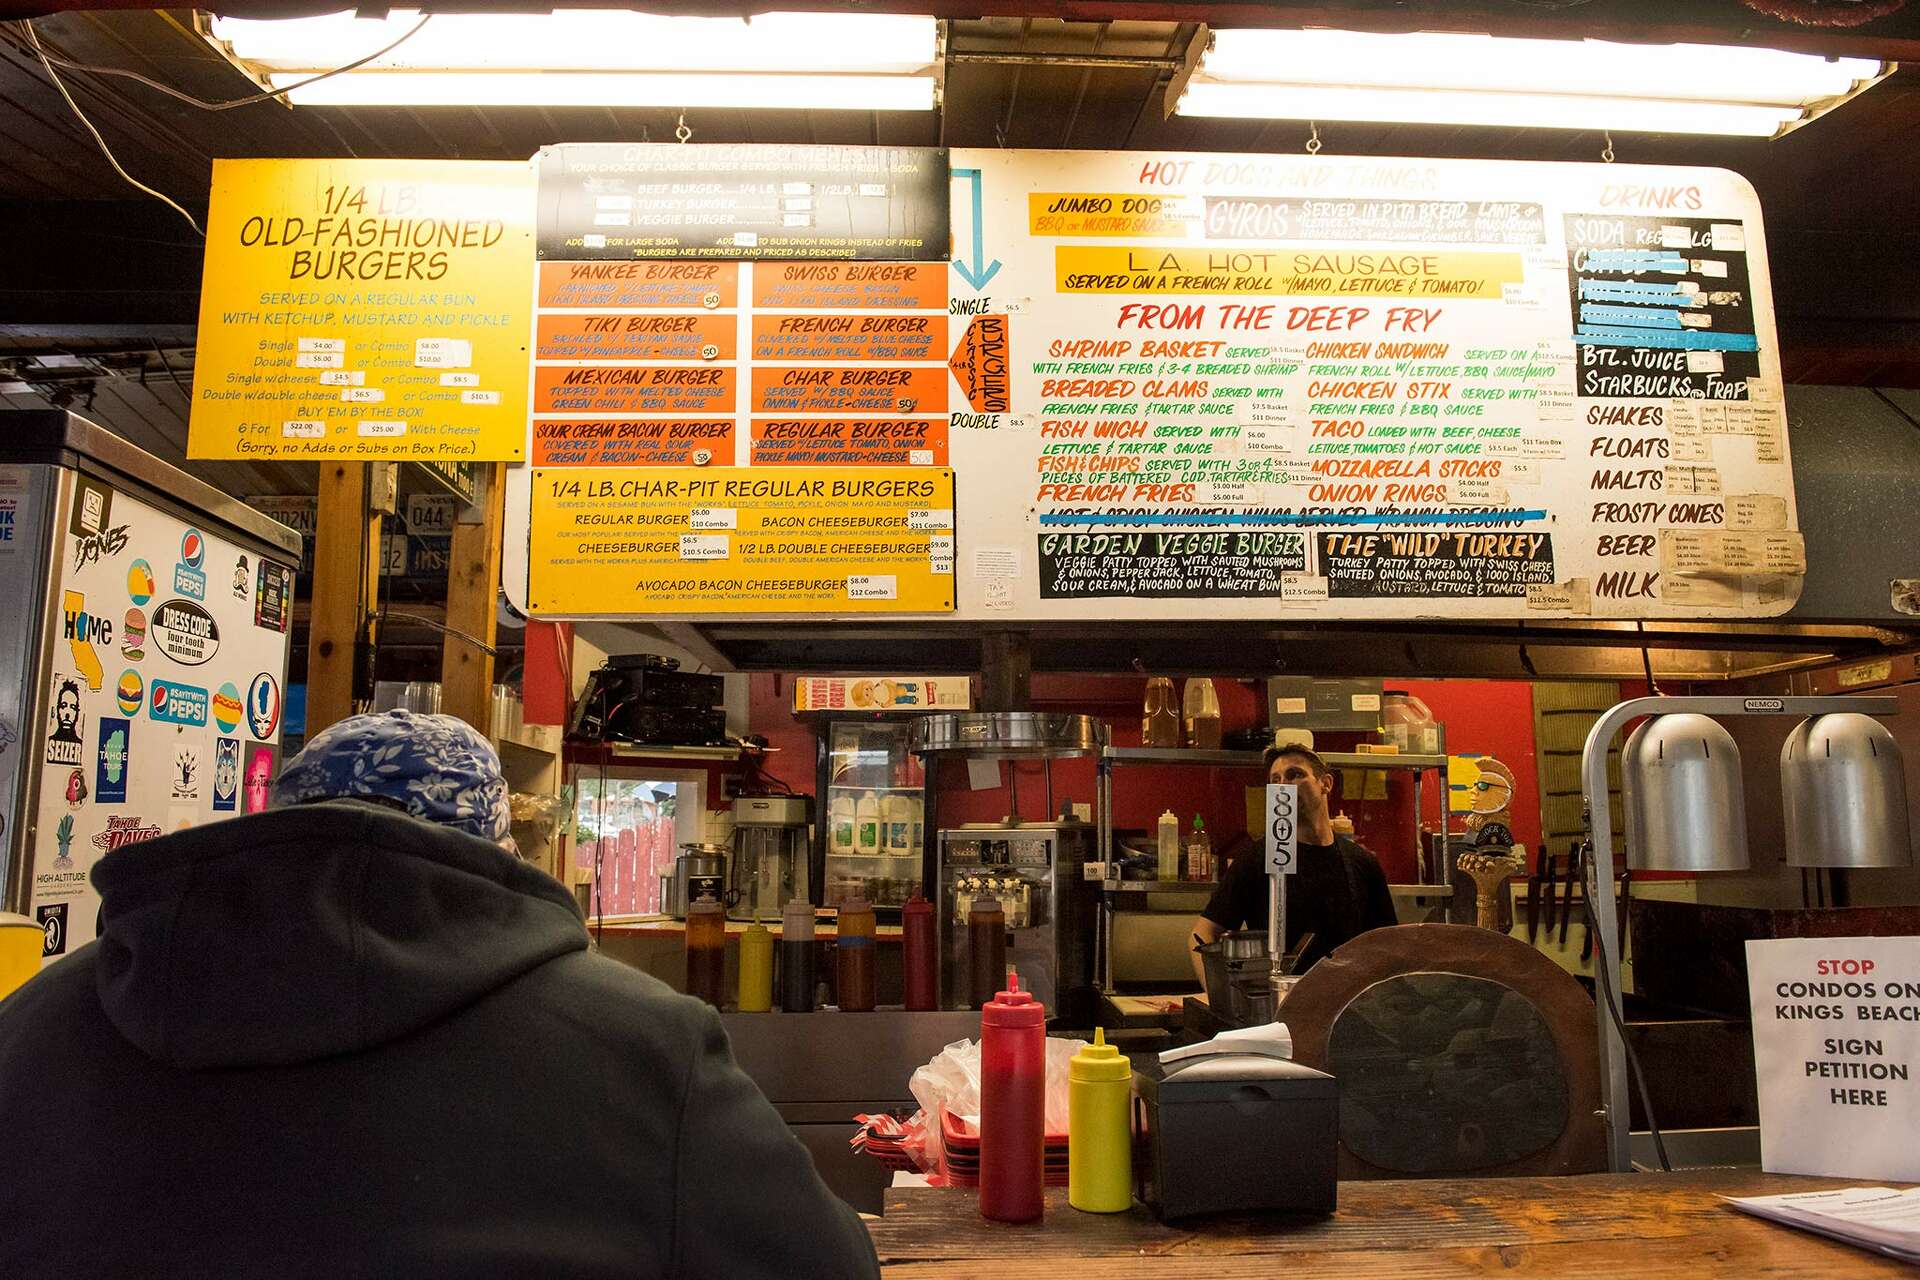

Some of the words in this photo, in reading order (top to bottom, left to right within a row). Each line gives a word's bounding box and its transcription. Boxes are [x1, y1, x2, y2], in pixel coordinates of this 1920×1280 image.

[1139, 161, 1194, 184] HOT
[324, 185, 368, 214] 1/4
[1048, 198, 1113, 214] JUMBO
[1122, 199, 1162, 213] DOG
[1599, 184, 1702, 210] DRINKS
[1210, 200, 1290, 235] GYROS
[240, 216, 503, 248] OLD-FASHIONED
[1575, 220, 1624, 242] SODA
[290, 251, 449, 281] BURGERS
[571, 265, 639, 280] YANKEE
[646, 265, 720, 281] BURGER
[1209, 255, 1277, 273] HOT
[1294, 254, 1440, 275] SAUSAGE
[784, 266, 841, 281] SWISS
[847, 266, 918, 282] BURGER
[1065, 274, 1130, 289] SERVED
[1133, 276, 1154, 290] ON
[1157, 277, 1167, 289] A
[1173, 276, 1229, 290] FRENCH
[1233, 277, 1273, 290] ROLL
[1340, 279, 1404, 292] LETTUCE
[1422, 280, 1484, 294] TOMATO!
[949, 297, 991, 316] SINGLE
[223, 313, 260, 325] WITH
[343, 313, 418, 326] MUSTARD
[423, 313, 455, 326] AND
[460, 313, 510, 326] PICKLE
[585, 317, 622, 333] TIKI
[629, 317, 697, 333] BURGER
[780, 317, 849, 334] FRENCH
[856, 317, 930, 334] BURGER
[1117, 304, 1203, 330] FROM
[1220, 305, 1274, 330] THE
[1286, 306, 1370, 332] DEEP
[1385, 307, 1442, 333] FRY
[1048, 340, 1132, 358] SHRIMP
[1140, 340, 1226, 358] BASKET
[1225, 347, 1271, 358] SERVED
[1306, 342, 1371, 359] CHICKEN
[1375, 342, 1449, 359] SANDWICH
[977, 318, 1006, 412] BURGERS
[1631, 349, 1686, 370] JUICE
[564, 370, 650, 386] MEXICAN
[655, 370, 723, 386] BURGER
[783, 370, 834, 386] CHAR
[840, 370, 913, 386] BURGER
[1585, 369, 1692, 395] STARBUCKS
[1707, 373, 1748, 400] FRAP
[1040, 379, 1135, 398] BREADED
[1142, 380, 1209, 398] CLAMS
[1308, 381, 1397, 399] CHICKEN
[1406, 381, 1452, 399] STIX
[950, 412, 1000, 430] DOUBLE
[1587, 406, 1663, 426] SHAKES
[537, 423, 571, 440] SOUR
[573, 423, 615, 439] CREAM
[618, 423, 665, 439] BACON
[669, 423, 732, 439] BURGER
[764, 422, 844, 439] REGULAR
[850, 422, 930, 439] BURGER
[1040, 421, 1084, 439] FISH
[1093, 421, 1148, 438] WICH
[1311, 420, 1365, 438] TACO
[236, 440, 278, 455] (Sorry,
[282, 444, 298, 454] no
[302, 442, 335, 454] Adds
[339, 444, 353, 454] or
[357, 442, 389, 454] Subs
[392, 444, 407, 454] on
[412, 443, 433, 454] Box
[1589, 437, 1669, 458] FLOATS
[1311, 459, 1431, 479] MOZZARELLA
[1439, 460, 1502, 478] STICKS
[1590, 469, 1663, 490] MALTS
[551, 481, 582, 498] 1/4
[620, 480, 721, 498] CHAR-PIT
[724, 480, 826, 498] REGULAR
[832, 480, 935, 498] BURGERS
[1037, 484, 1126, 503] FRENCH
[1133, 484, 1196, 502] FRIES
[1308, 484, 1379, 503] ONION
[1383, 484, 1447, 503] RINGS
[575, 514, 633, 525] REGULAR
[638, 514, 689, 525] BURGER
[762, 516, 805, 528] BACON
[810, 516, 909, 528] CHEESEBURGER
[1591, 502, 1667, 523] FROSTY
[1669, 503, 1725, 524] CONES
[691, 520, 703, 528] $10
[910, 522, 922, 530] $11
[924, 522, 948, 530] Combo
[577, 542, 680, 554] CHEESEBURGER
[738, 544, 757, 555] 1/2
[778, 544, 833, 555] DOUBLE
[836, 544, 930, 555] CHEESEBURGER
[1040, 533, 1143, 556] GARDEN
[1156, 533, 1229, 556] VEGGIE
[1236, 533, 1304, 556] BURGER
[1326, 533, 1380, 556] THE
[1457, 533, 1545, 558] TURKEY
[1596, 535, 1656, 557] BEER
[176, 576, 203, 596] PEPSI
[635, 580, 695, 591] AVOCADO
[700, 580, 744, 591] BACON
[748, 579, 847, 591] CHEESEBURGER
[850, 577, 869, 585] $8.00
[1595, 571, 1660, 599] MILK
[163, 607, 190, 632] DRESS
[190, 615, 211, 638] CODE
[168, 700, 206, 722] PEPSI
[47, 739, 82, 763] SEIZER
[100, 750, 128, 761] TAHOE
[37, 872, 53, 883] HIGH
[55, 872, 86, 882] ALTITUDE
[1817, 959, 1875, 976] STOP
[1776, 982, 1877, 999] CONDOS
[1884, 982, 1920, 999] ON
[1775, 1005, 1844, 1020] KINGS
[1824, 1038, 1883, 1056] SIGN
[1805, 1061, 1908, 1081] PETITION
[1830, 1088, 1888, 1106] HERE
